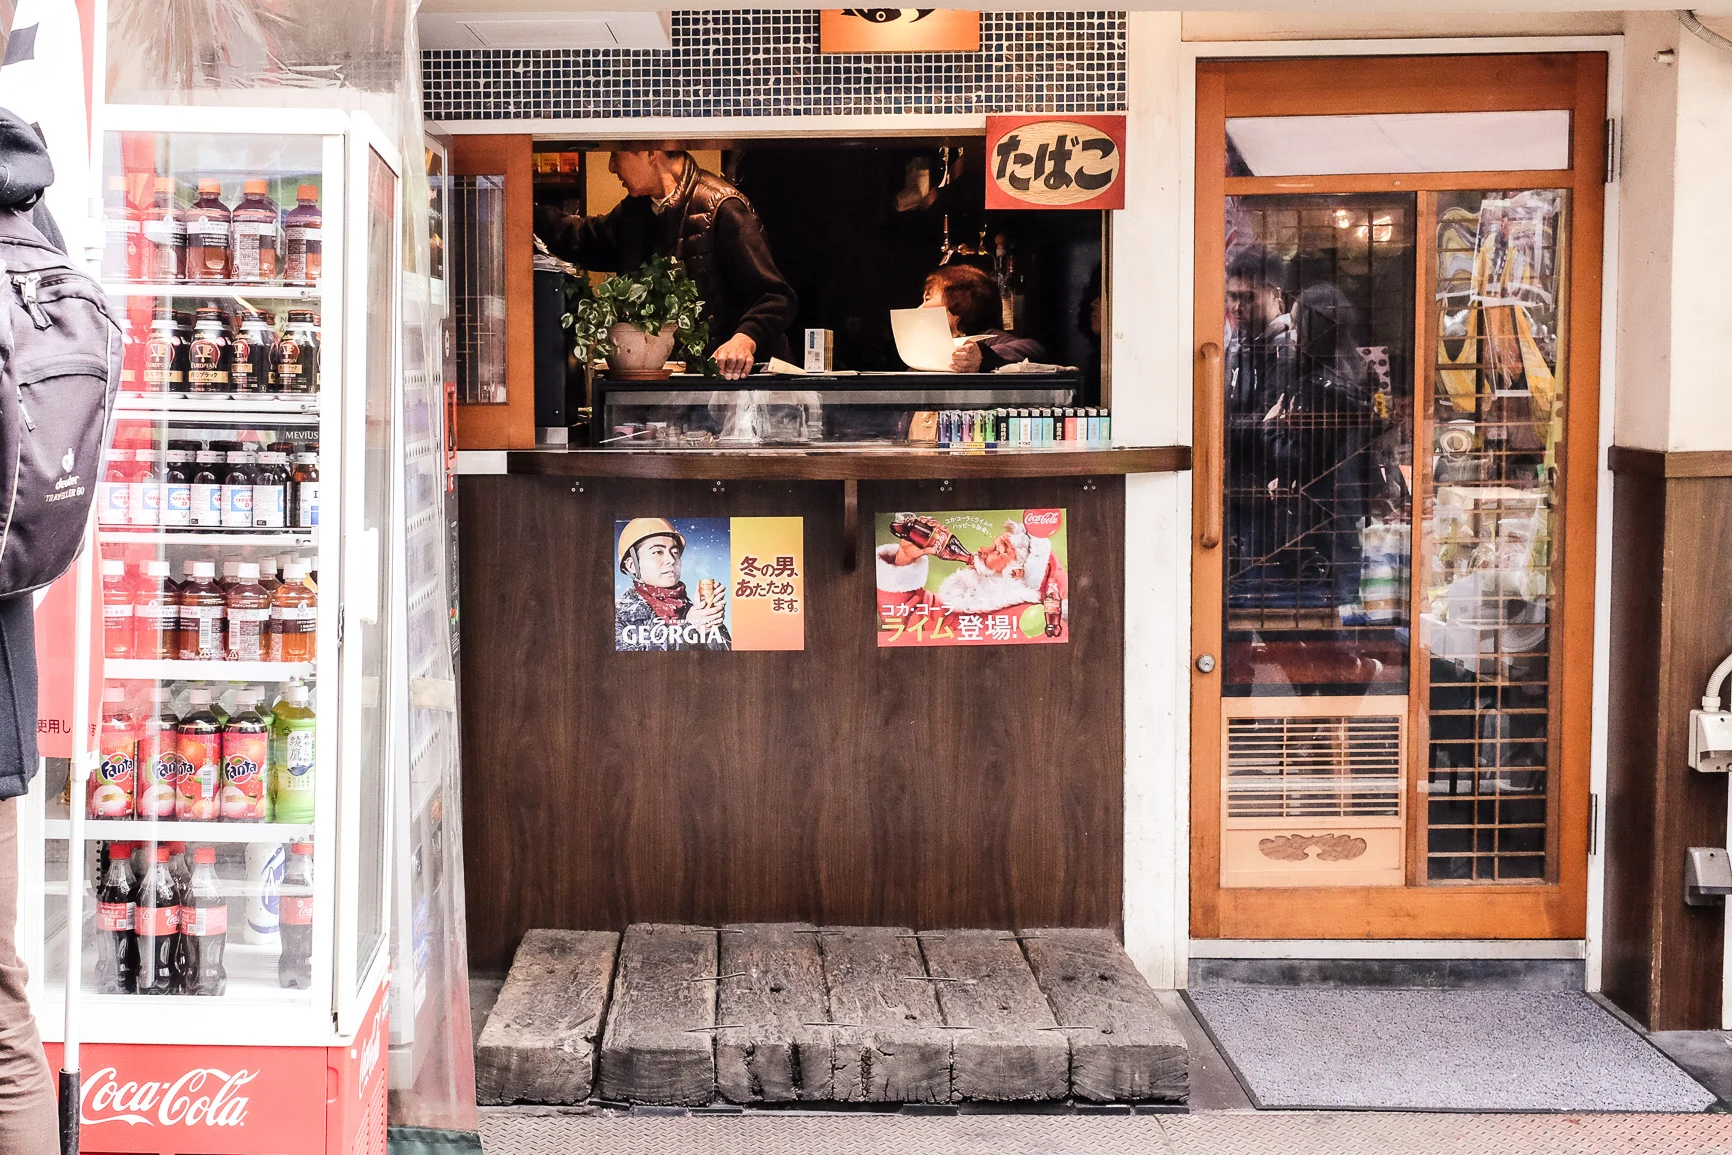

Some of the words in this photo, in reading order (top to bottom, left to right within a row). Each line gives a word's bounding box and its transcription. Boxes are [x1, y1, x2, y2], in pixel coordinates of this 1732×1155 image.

[995, 134, 1116, 191] たばこ
[285, 431, 319, 440] MEVIUS
[55, 474, 80, 490] deuter
[1024, 512, 1060, 525] Coca-Cola
[739, 556, 799, 578] 冬の男、
[735, 578, 794, 598] あたため
[772, 597, 799, 613] ます。
[881, 602, 955, 617] コカ・コーラ
[622, 624, 724, 645] GEORGIA
[100, 757, 134, 781] Fanta
[151, 758, 177, 780] Fan
[225, 759, 259, 782] Fanta
[79, 1066, 261, 1128] Coca-Cola
